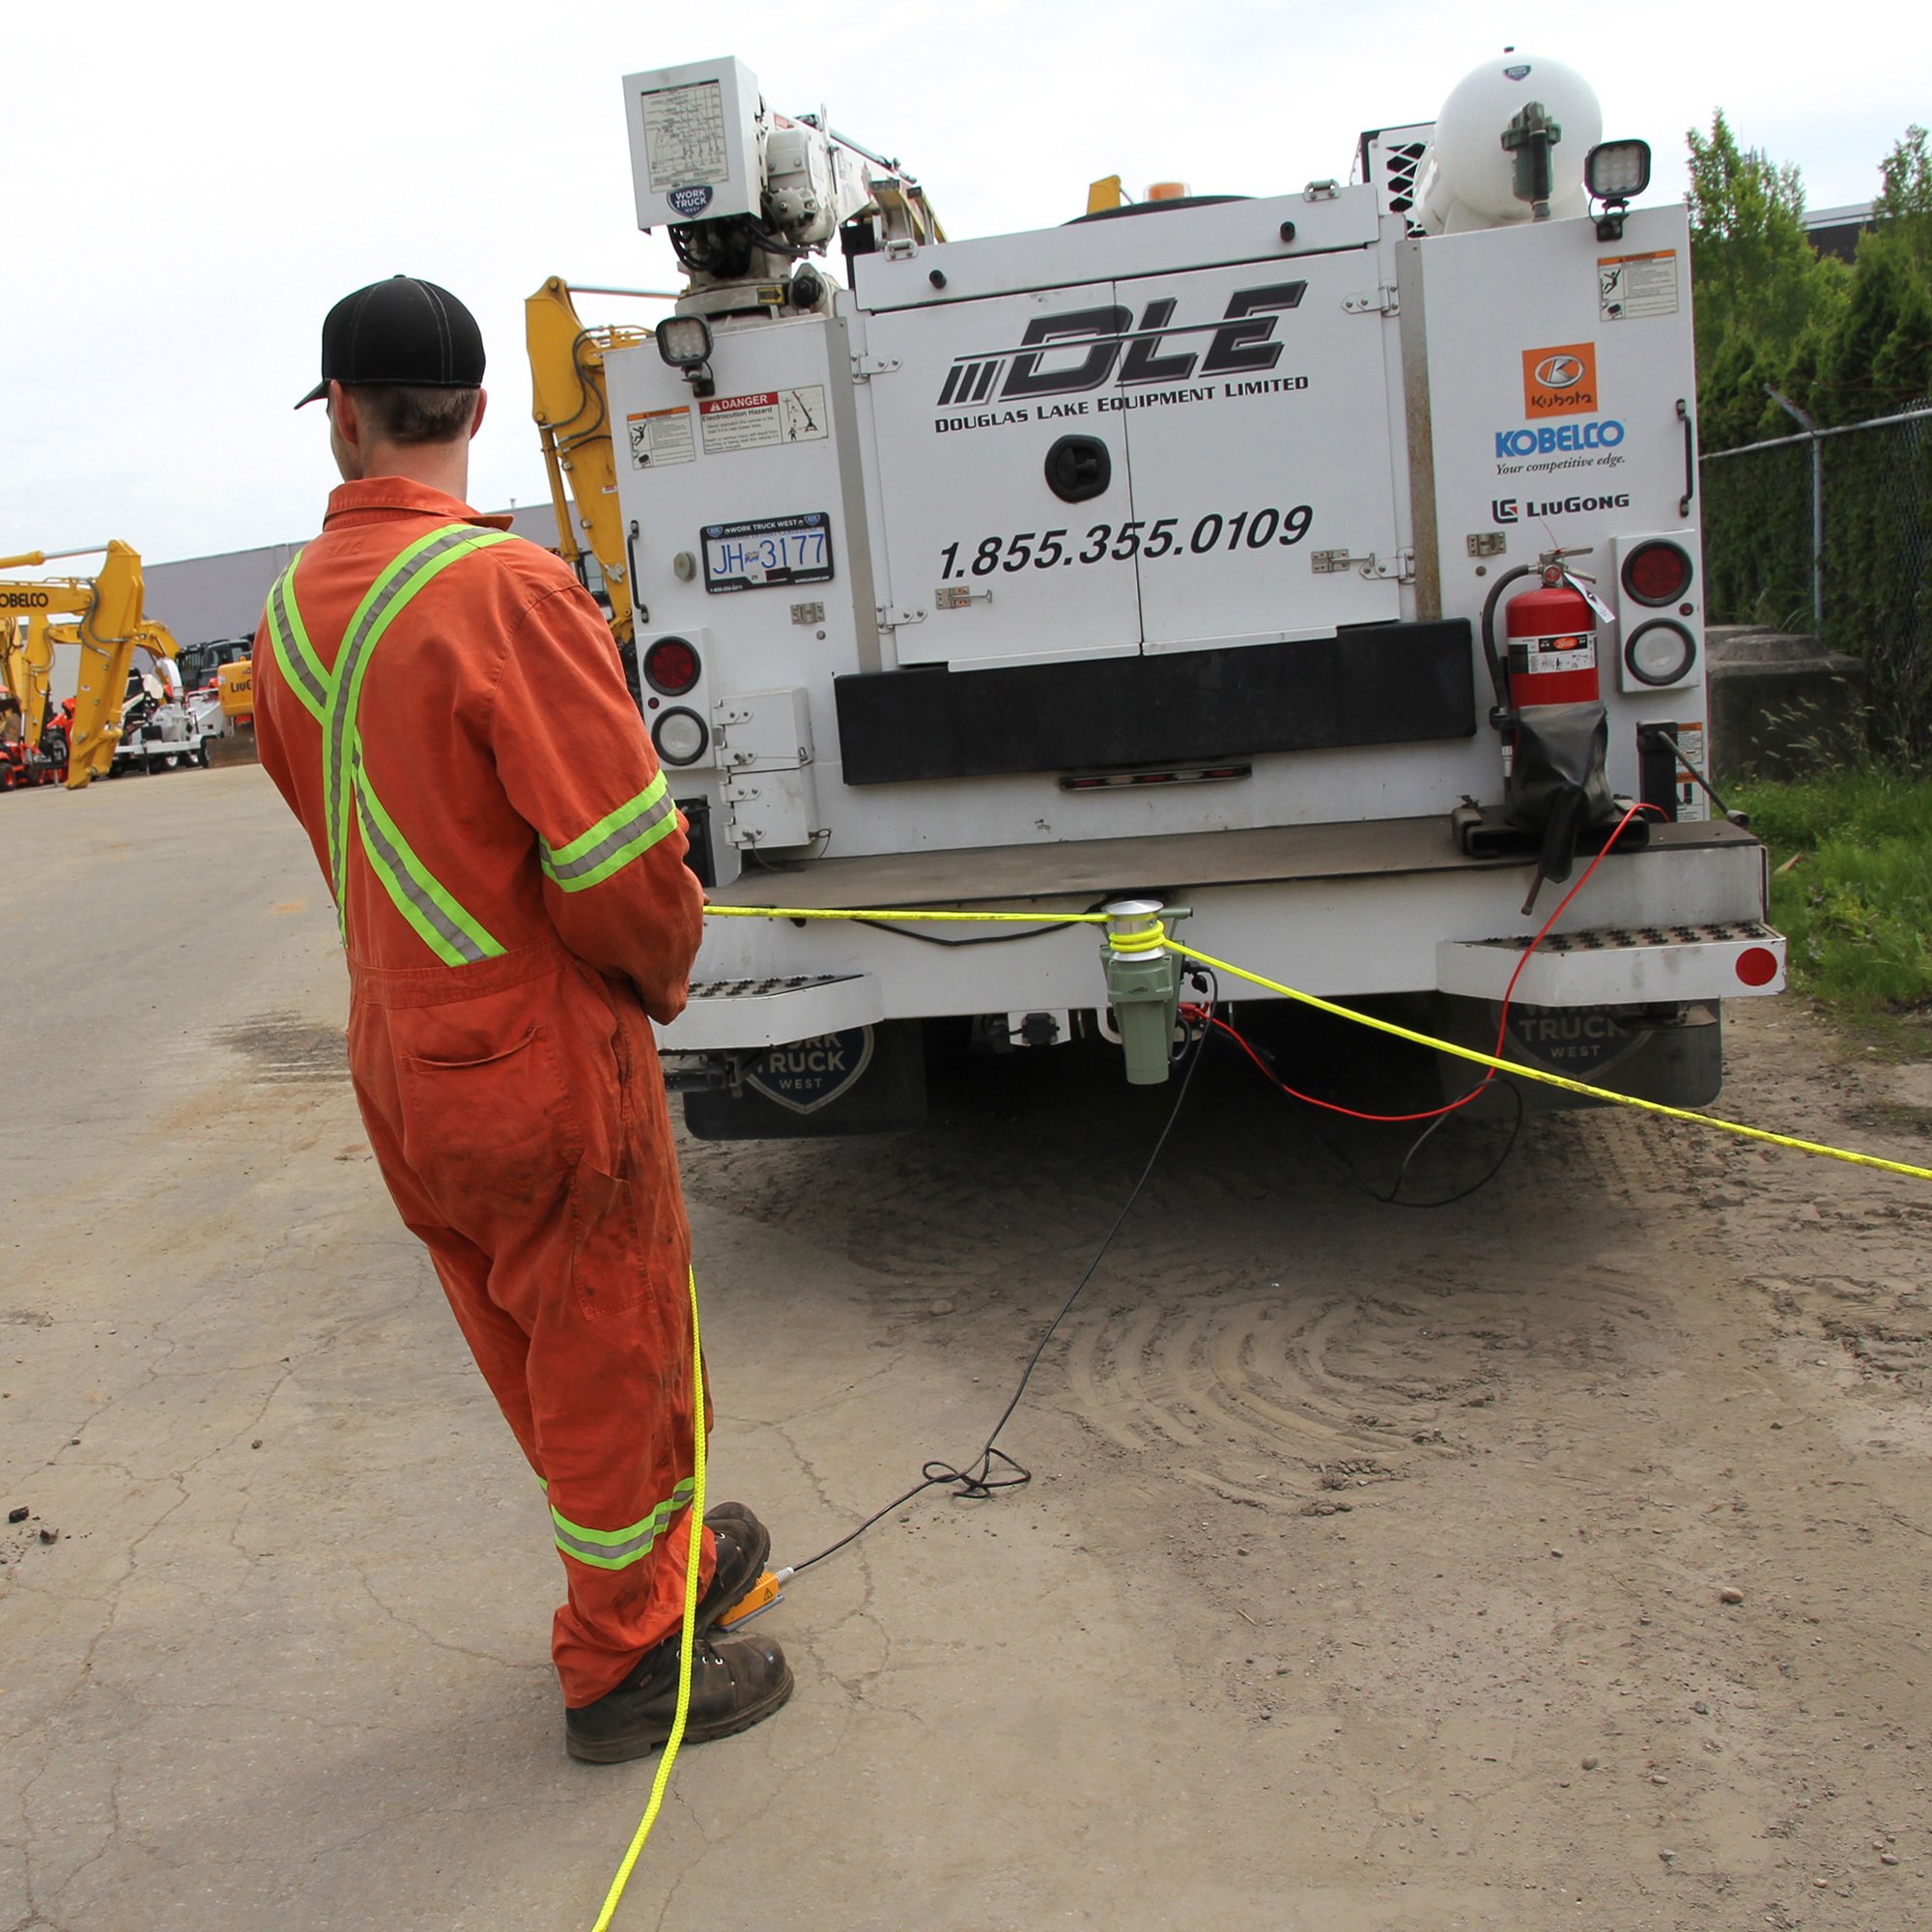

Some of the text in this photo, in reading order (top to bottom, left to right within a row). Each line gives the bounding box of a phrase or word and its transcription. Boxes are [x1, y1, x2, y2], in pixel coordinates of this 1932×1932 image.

[675, 188, 705, 200] WORK
[675, 196, 707, 209] TRUCK
[722, 394, 768, 410] DANGER
[935, 376, 1309, 433] DOUGLAS LAKE EQUIPMENT LIMITED
[1531, 391, 1593, 409] Kubota
[702, 407, 773, 422] Electrocution Hazard
[1494, 420, 1625, 458] KOBELCO
[1496, 453, 1626, 475] Your competitive edge.
[729, 526, 752, 534] WORK
[753, 522, 776, 531] TRUCK
[777, 519, 797, 527] WEST
[940, 505, 1313, 580] 1.855.355.0109
[713, 543, 744, 575] JH
[759, 533, 824, 569] 3177
[1549, 1045, 1601, 1059] WEST
[757, 1051, 845, 1073] RUCK
[780, 1078, 822, 1089] WEST
